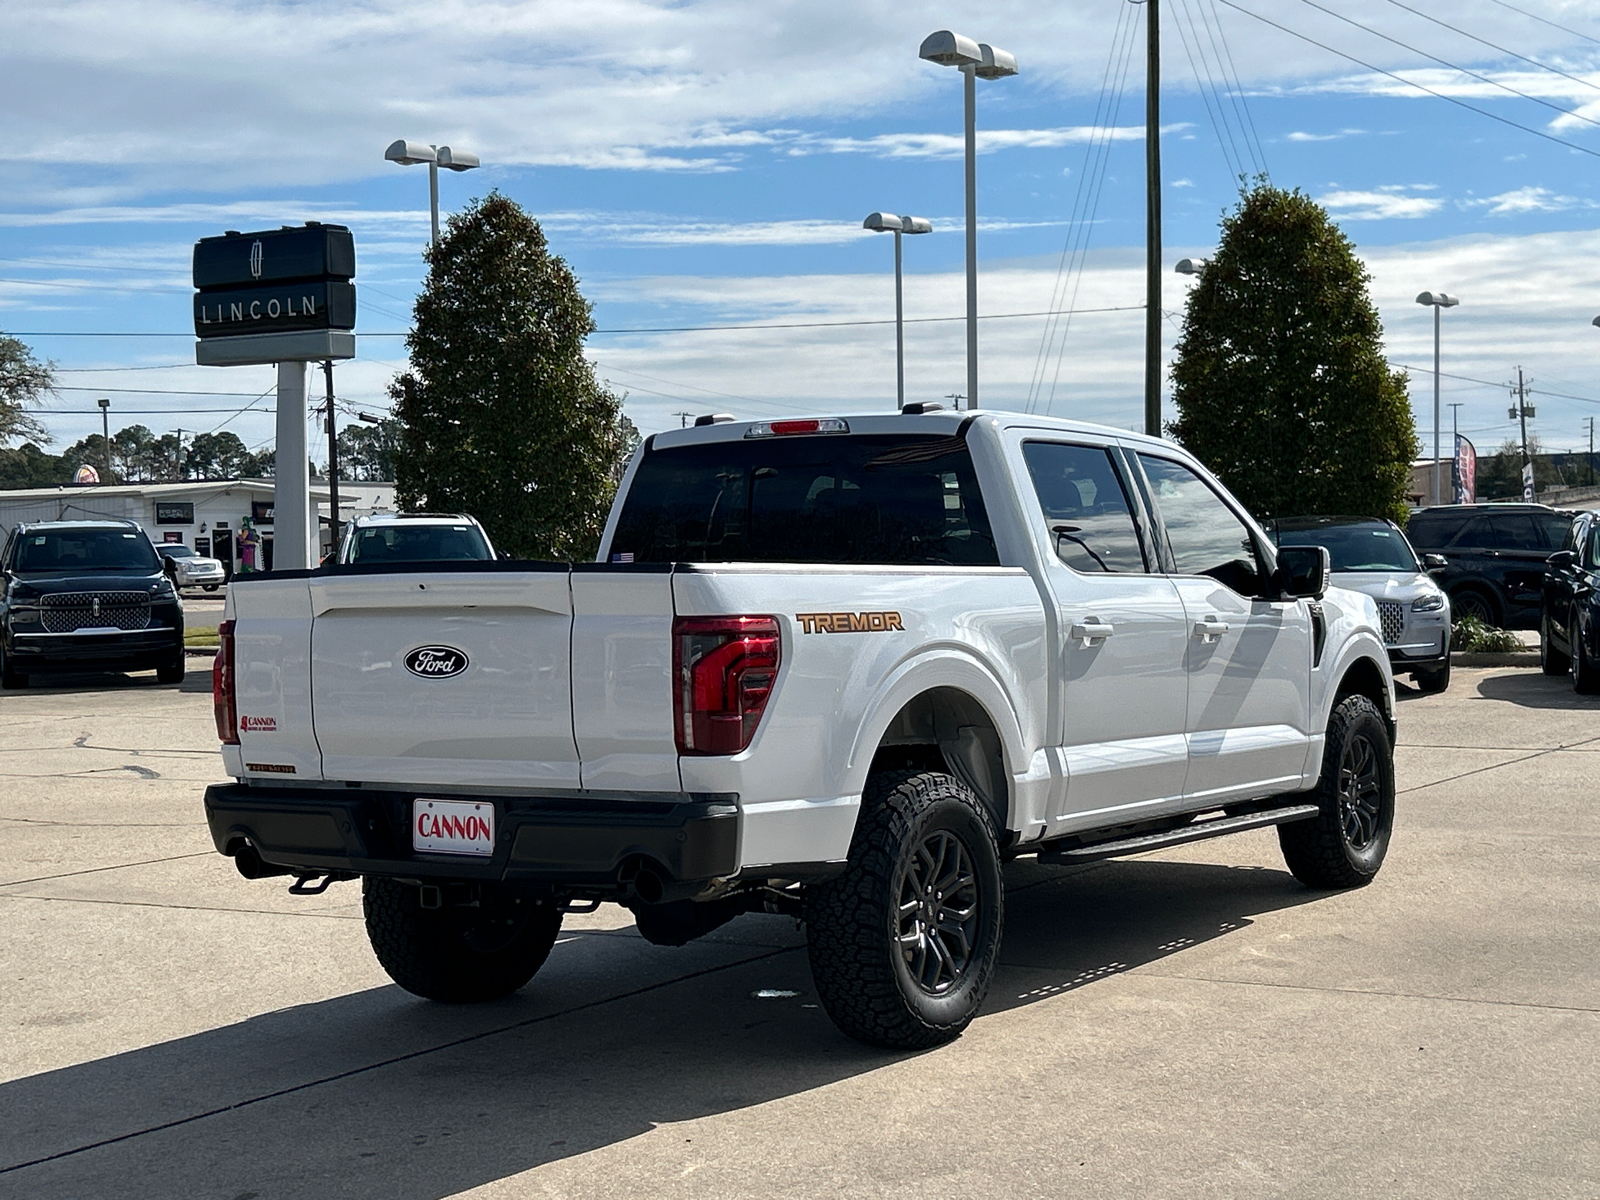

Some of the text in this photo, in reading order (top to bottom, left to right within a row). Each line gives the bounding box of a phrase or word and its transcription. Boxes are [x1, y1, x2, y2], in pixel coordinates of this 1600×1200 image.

[202, 295, 316, 324] LINCOLN
[796, 611, 905, 634] TREMOR
[415, 650, 456, 673] Ford
[248, 717, 276, 726] CANNON
[418, 813, 490, 842] CANNON
